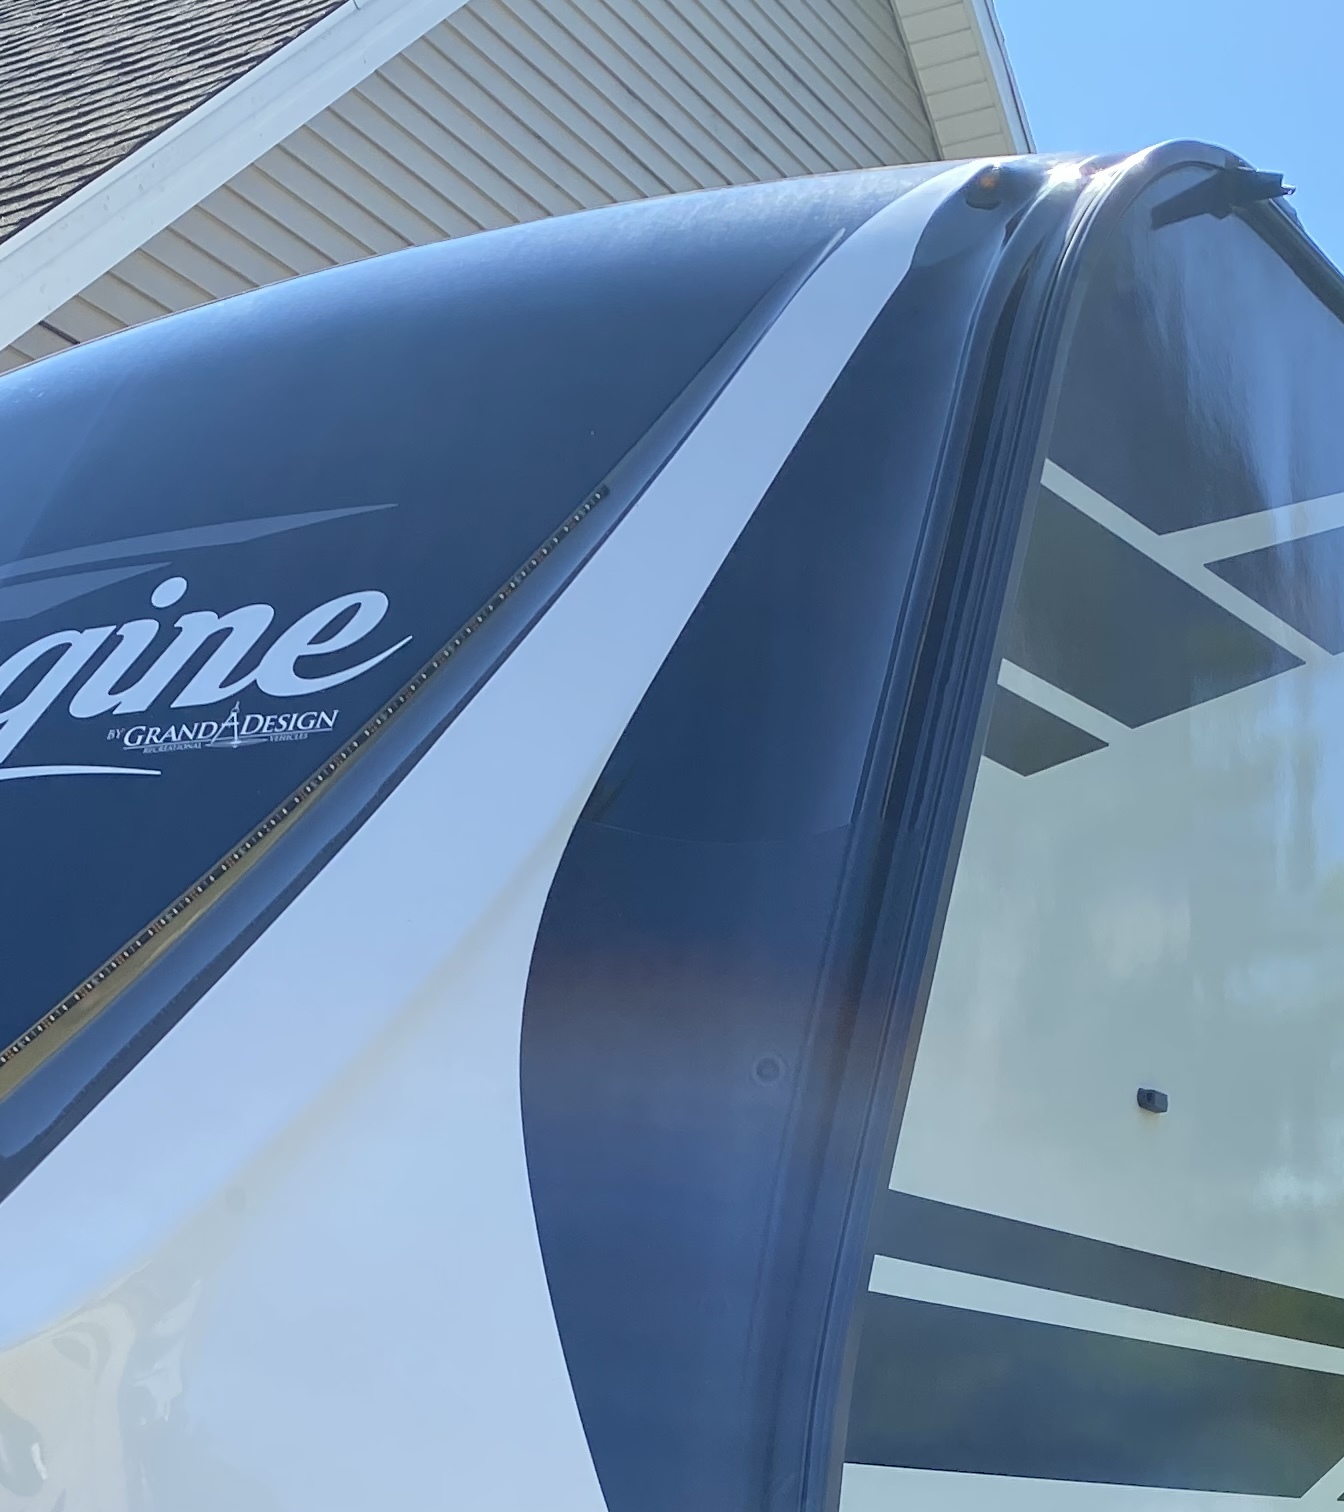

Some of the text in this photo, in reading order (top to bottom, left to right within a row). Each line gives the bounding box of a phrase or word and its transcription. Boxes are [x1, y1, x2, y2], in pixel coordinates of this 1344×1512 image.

[106, 709, 340, 747] BY GRAND DESIGN
[269, 733, 309, 743] VEHICLES
